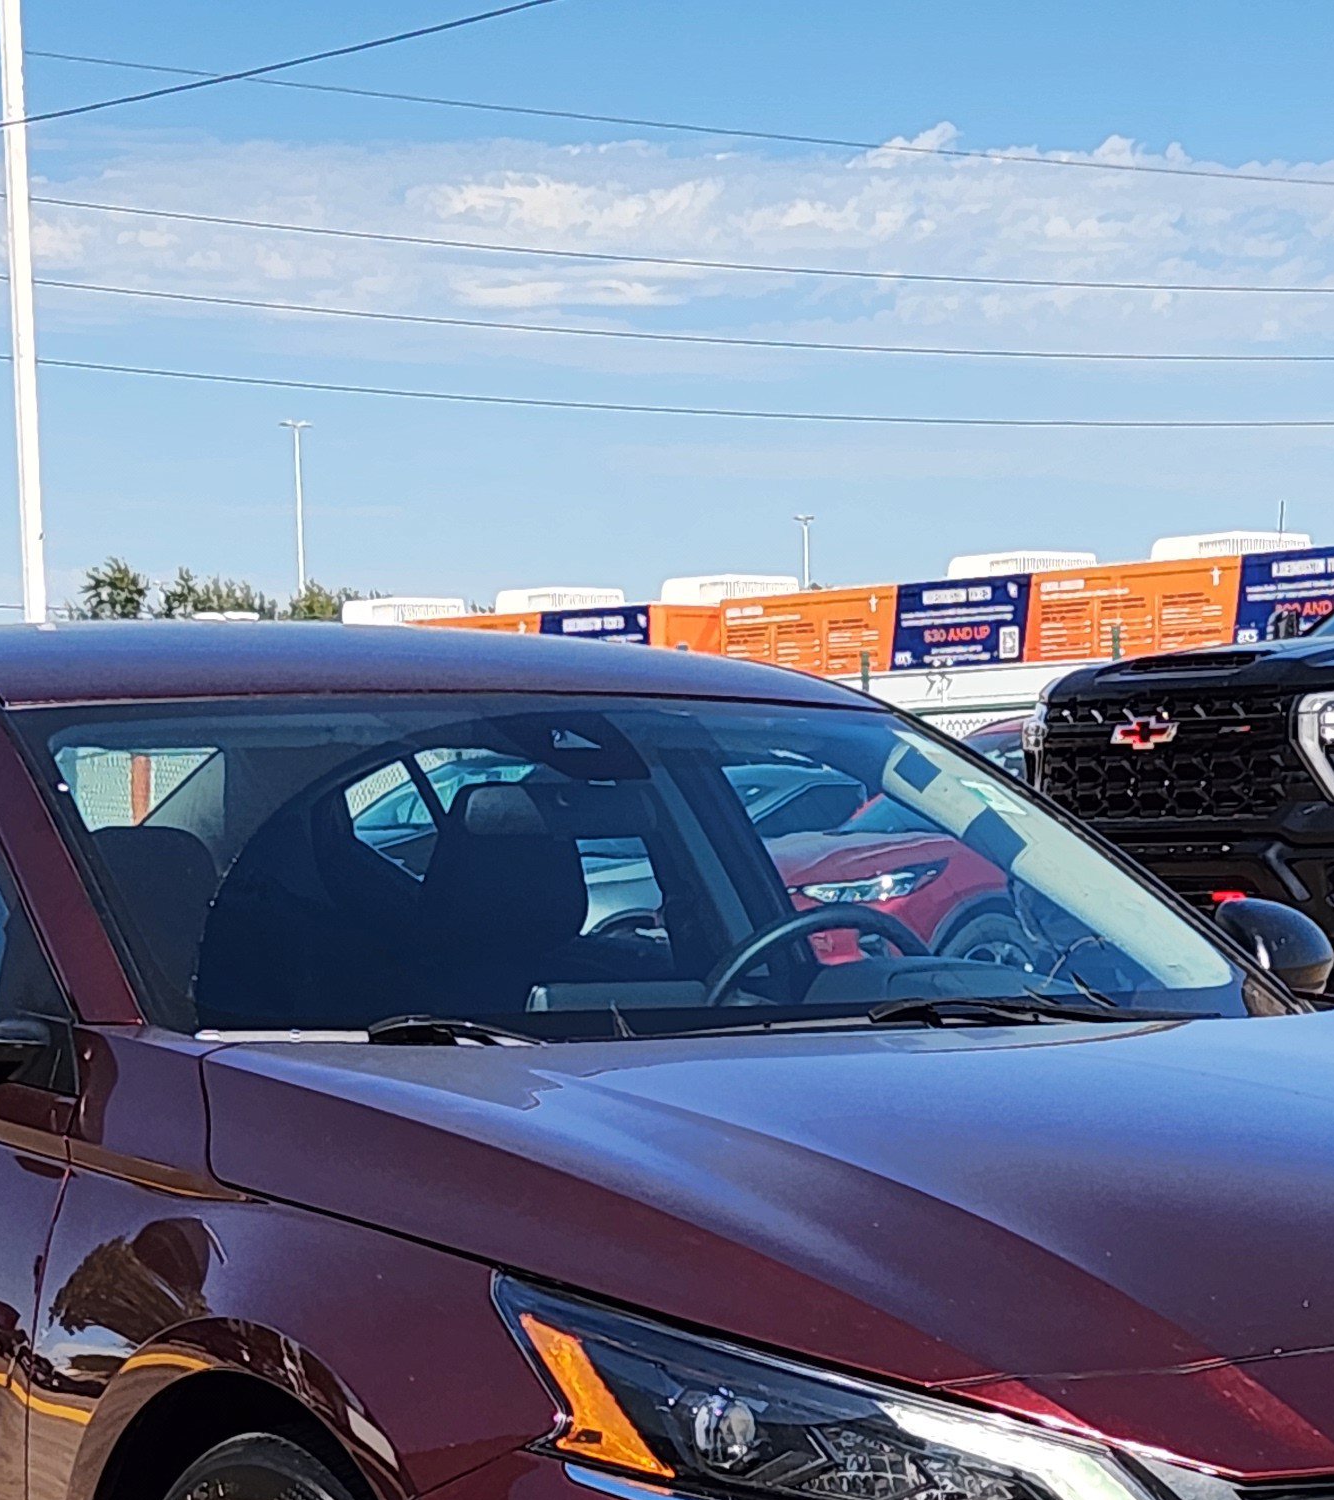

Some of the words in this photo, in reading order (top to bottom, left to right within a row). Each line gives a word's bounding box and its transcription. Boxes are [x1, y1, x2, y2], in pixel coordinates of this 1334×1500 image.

[1301, 600, 1333, 616] AND
[948, 626, 973, 641] AND
[974, 625, 991, 640] UP
